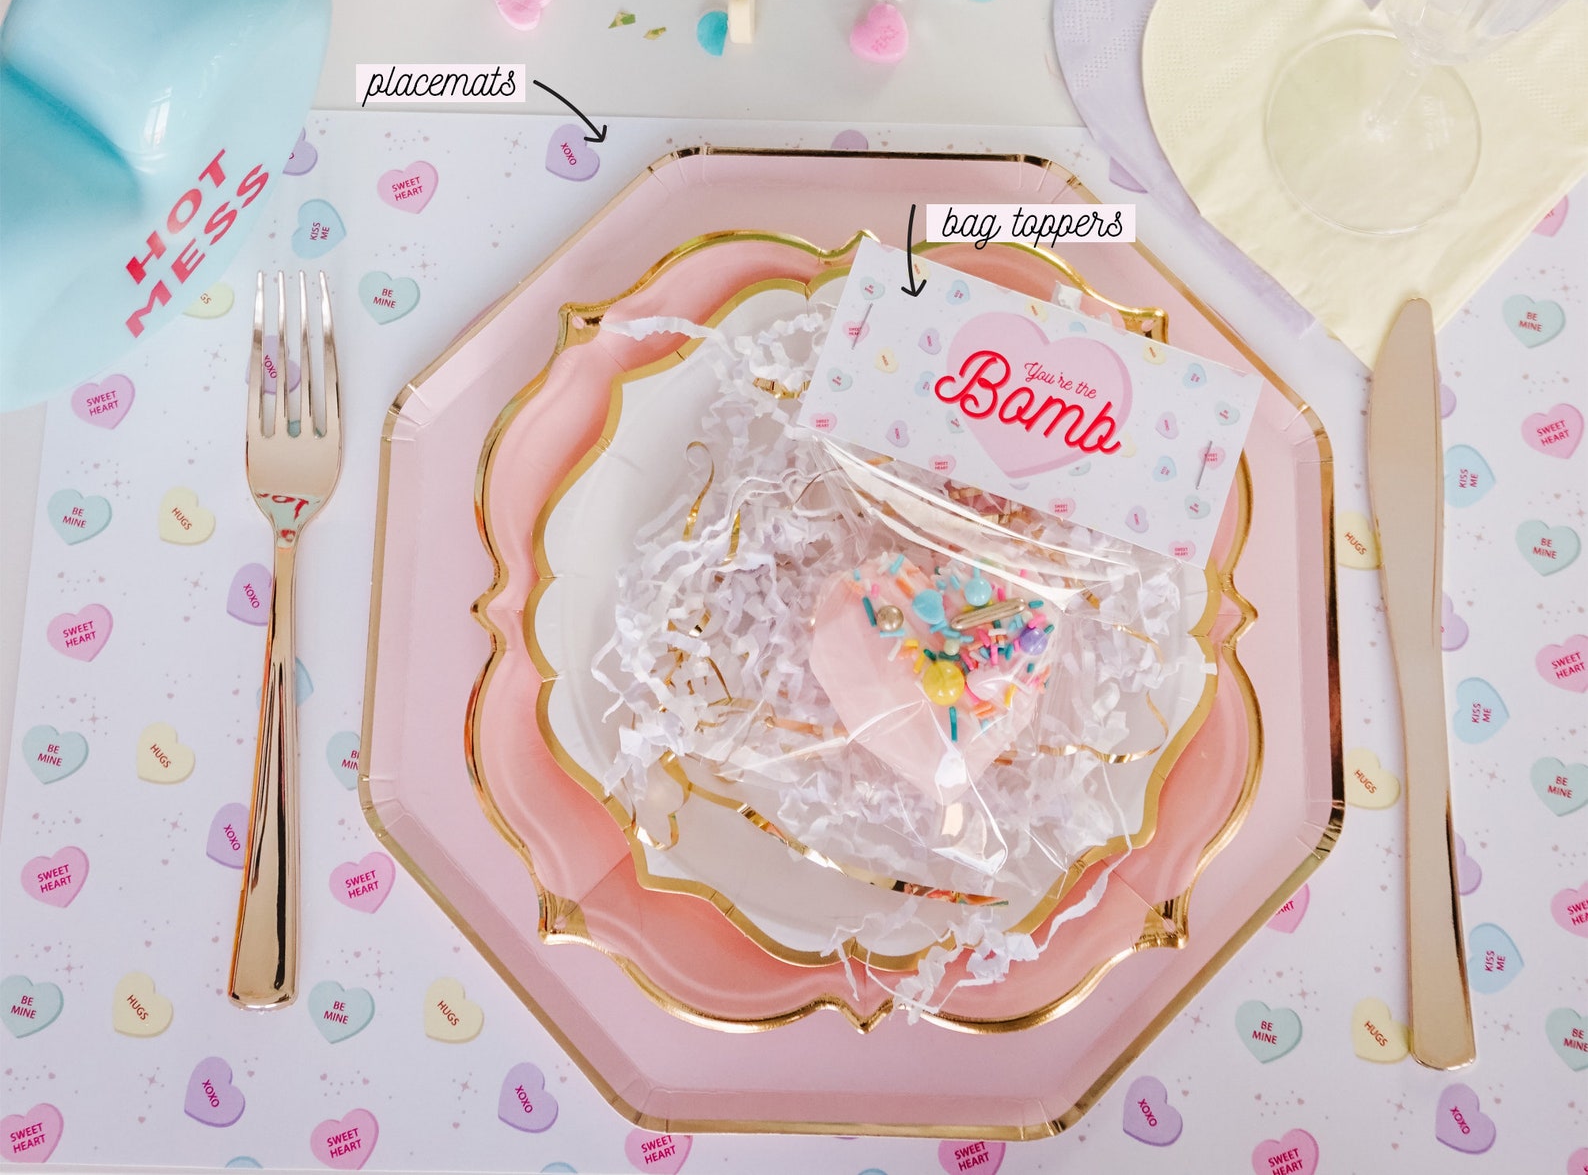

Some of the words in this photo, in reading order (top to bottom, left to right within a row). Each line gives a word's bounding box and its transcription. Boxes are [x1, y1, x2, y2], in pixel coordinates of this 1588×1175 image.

[560, 142, 577, 166] XOXO
[392, 176, 421, 192] SWEET
[395, 186, 423, 201] HEART
[126, 148, 226, 285] HOT
[310, 222, 321, 240] KISS
[320, 226, 330, 240] ME
[126, 164, 269, 339] MESS
[200, 293, 212, 305] GS
[382, 288, 393, 298] BE
[373, 297, 397, 309] MINE
[1526, 311, 1538, 321] BE
[1518, 320, 1543, 333] MINE
[1024, 362, 1074, 391] You're
[1075, 381, 1097, 399] the
[86, 390, 117, 407] SWEET
[935, 350, 1122, 455] Bomb
[89, 399, 120, 417] HEART
[1536, 419, 1566, 436] SWEET
[1540, 429, 1570, 446] HEART
[1459, 468, 1469, 488] KISS
[1470, 473, 1478, 487] ME
[72, 506, 84, 517] BE
[171, 507, 193, 531] HUGS
[62, 514, 87, 529] MINE
[1344, 531, 1367, 556] HUGS
[1541, 538, 1552, 547] BE
[1533, 546, 1557, 559] MINE
[243, 583, 261, 609] XOXO
[62, 620, 94, 638] SWEET
[65, 630, 97, 648] HEART
[1551, 651, 1581, 670] SWEET
[1555, 662, 1585, 679] HEART
[1472, 702, 1481, 724] KISS
[1483, 707, 1492, 723] ME
[47, 743, 60, 754] BE
[149, 743, 172, 769] HUGS
[351, 750, 359, 759] B
[38, 752, 62, 767] MINE
[341, 759, 358, 771] MIN
[1354, 769, 1377, 794] HUGS
[1556, 776, 1568, 786] BE
[1547, 785, 1573, 799] MINE
[223, 824, 241, 851] XOXO
[37, 863, 70, 883] SWEET
[345, 869, 377, 889] SWEET
[39, 873, 72, 894] HEART
[347, 879, 380, 899] HEART
[1567, 899, 1588, 916] SWE
[1484, 950, 1495, 972] KISS
[1496, 955, 1506, 971] ME
[20, 995, 33, 1006] BE
[126, 993, 149, 1021] HUGS
[332, 1000, 346, 1012] BE
[11, 1003, 37, 1019] MINE
[323, 1009, 349, 1024] MINE
[437, 1000, 460, 1026] HUGS
[1260, 1020, 1273, 1032] BE
[1364, 1021, 1388, 1047] HUGS
[1572, 1028, 1584, 1039] BE
[1252, 1030, 1278, 1045] MINE
[1563, 1037, 1588, 1052] MINE
[201, 1079, 220, 1108] XOXO
[514, 1085, 533, 1114] XOXO
[1138, 1098, 1158, 1127] XOXO
[1450, 1106, 1471, 1135] XOXO
[9, 1122, 44, 1142] SWEET
[327, 1127, 359, 1147] SWEET
[13, 1133, 47, 1153] HEART
[330, 1137, 362, 1159] HEART
[640, 1135, 673, 1154] SWEET
[954, 1141, 986, 1161] SWEET
[644, 1145, 676, 1165] HEART
[957, 1151, 990, 1172] HEART
[1268, 1148, 1300, 1168] SWEET
[1272, 1160, 1304, 1175] HEART
